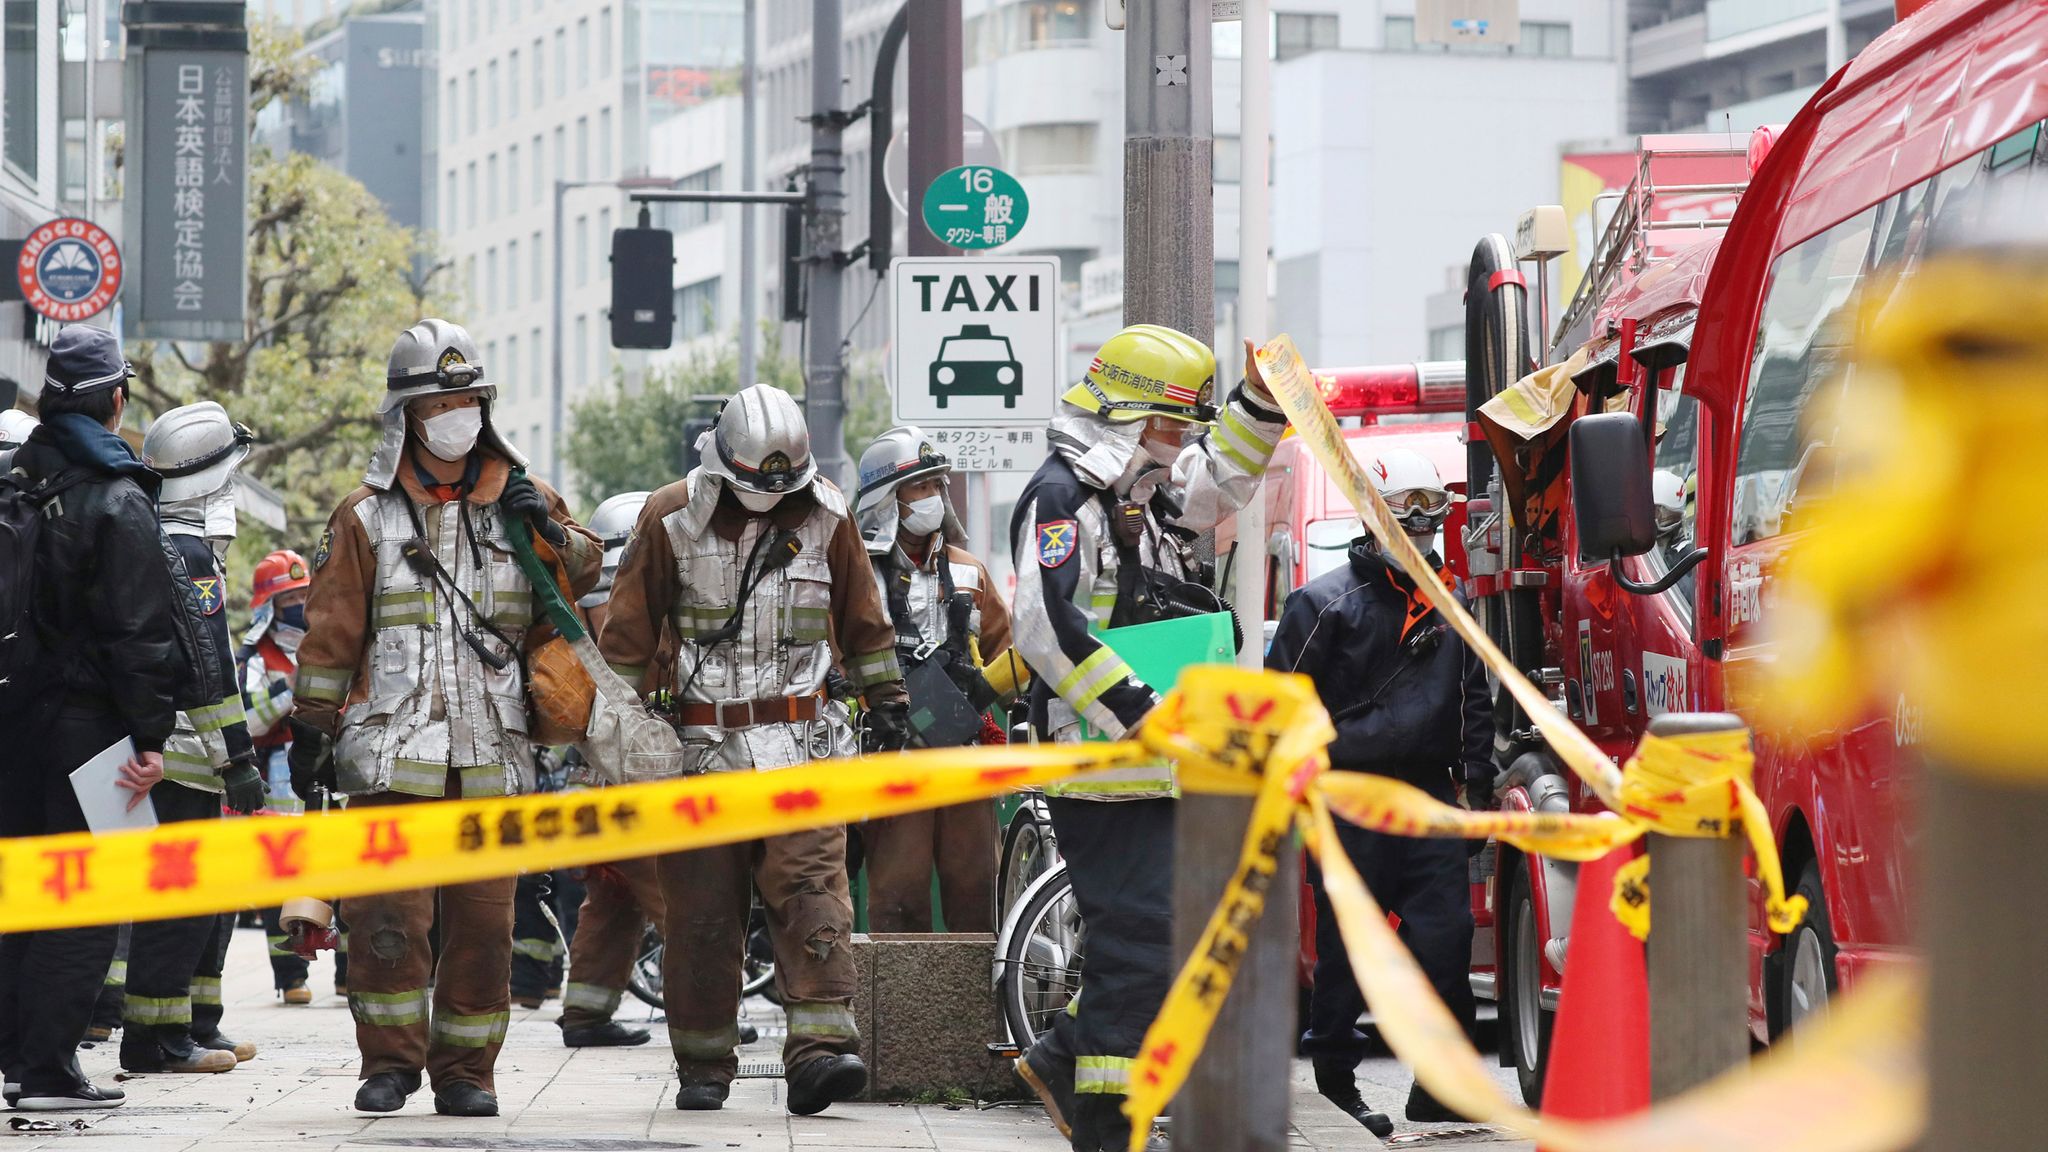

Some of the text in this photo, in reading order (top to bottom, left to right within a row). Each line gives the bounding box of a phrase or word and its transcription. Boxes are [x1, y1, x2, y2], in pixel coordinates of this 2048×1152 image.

[213, 66, 232, 185] 公益財団法人
[174, 64, 205, 311] 日本英語検定協会
[960, 168, 994, 193] 16
[20, 221, 118, 269] CHOCOCRO
[946, 225, 1007, 244] タクシー専用
[912, 275, 1039, 312] TAXI
[1098, 362, 1166, 396] 大阪市消防局
[958, 445, 996, 456] 22-1
